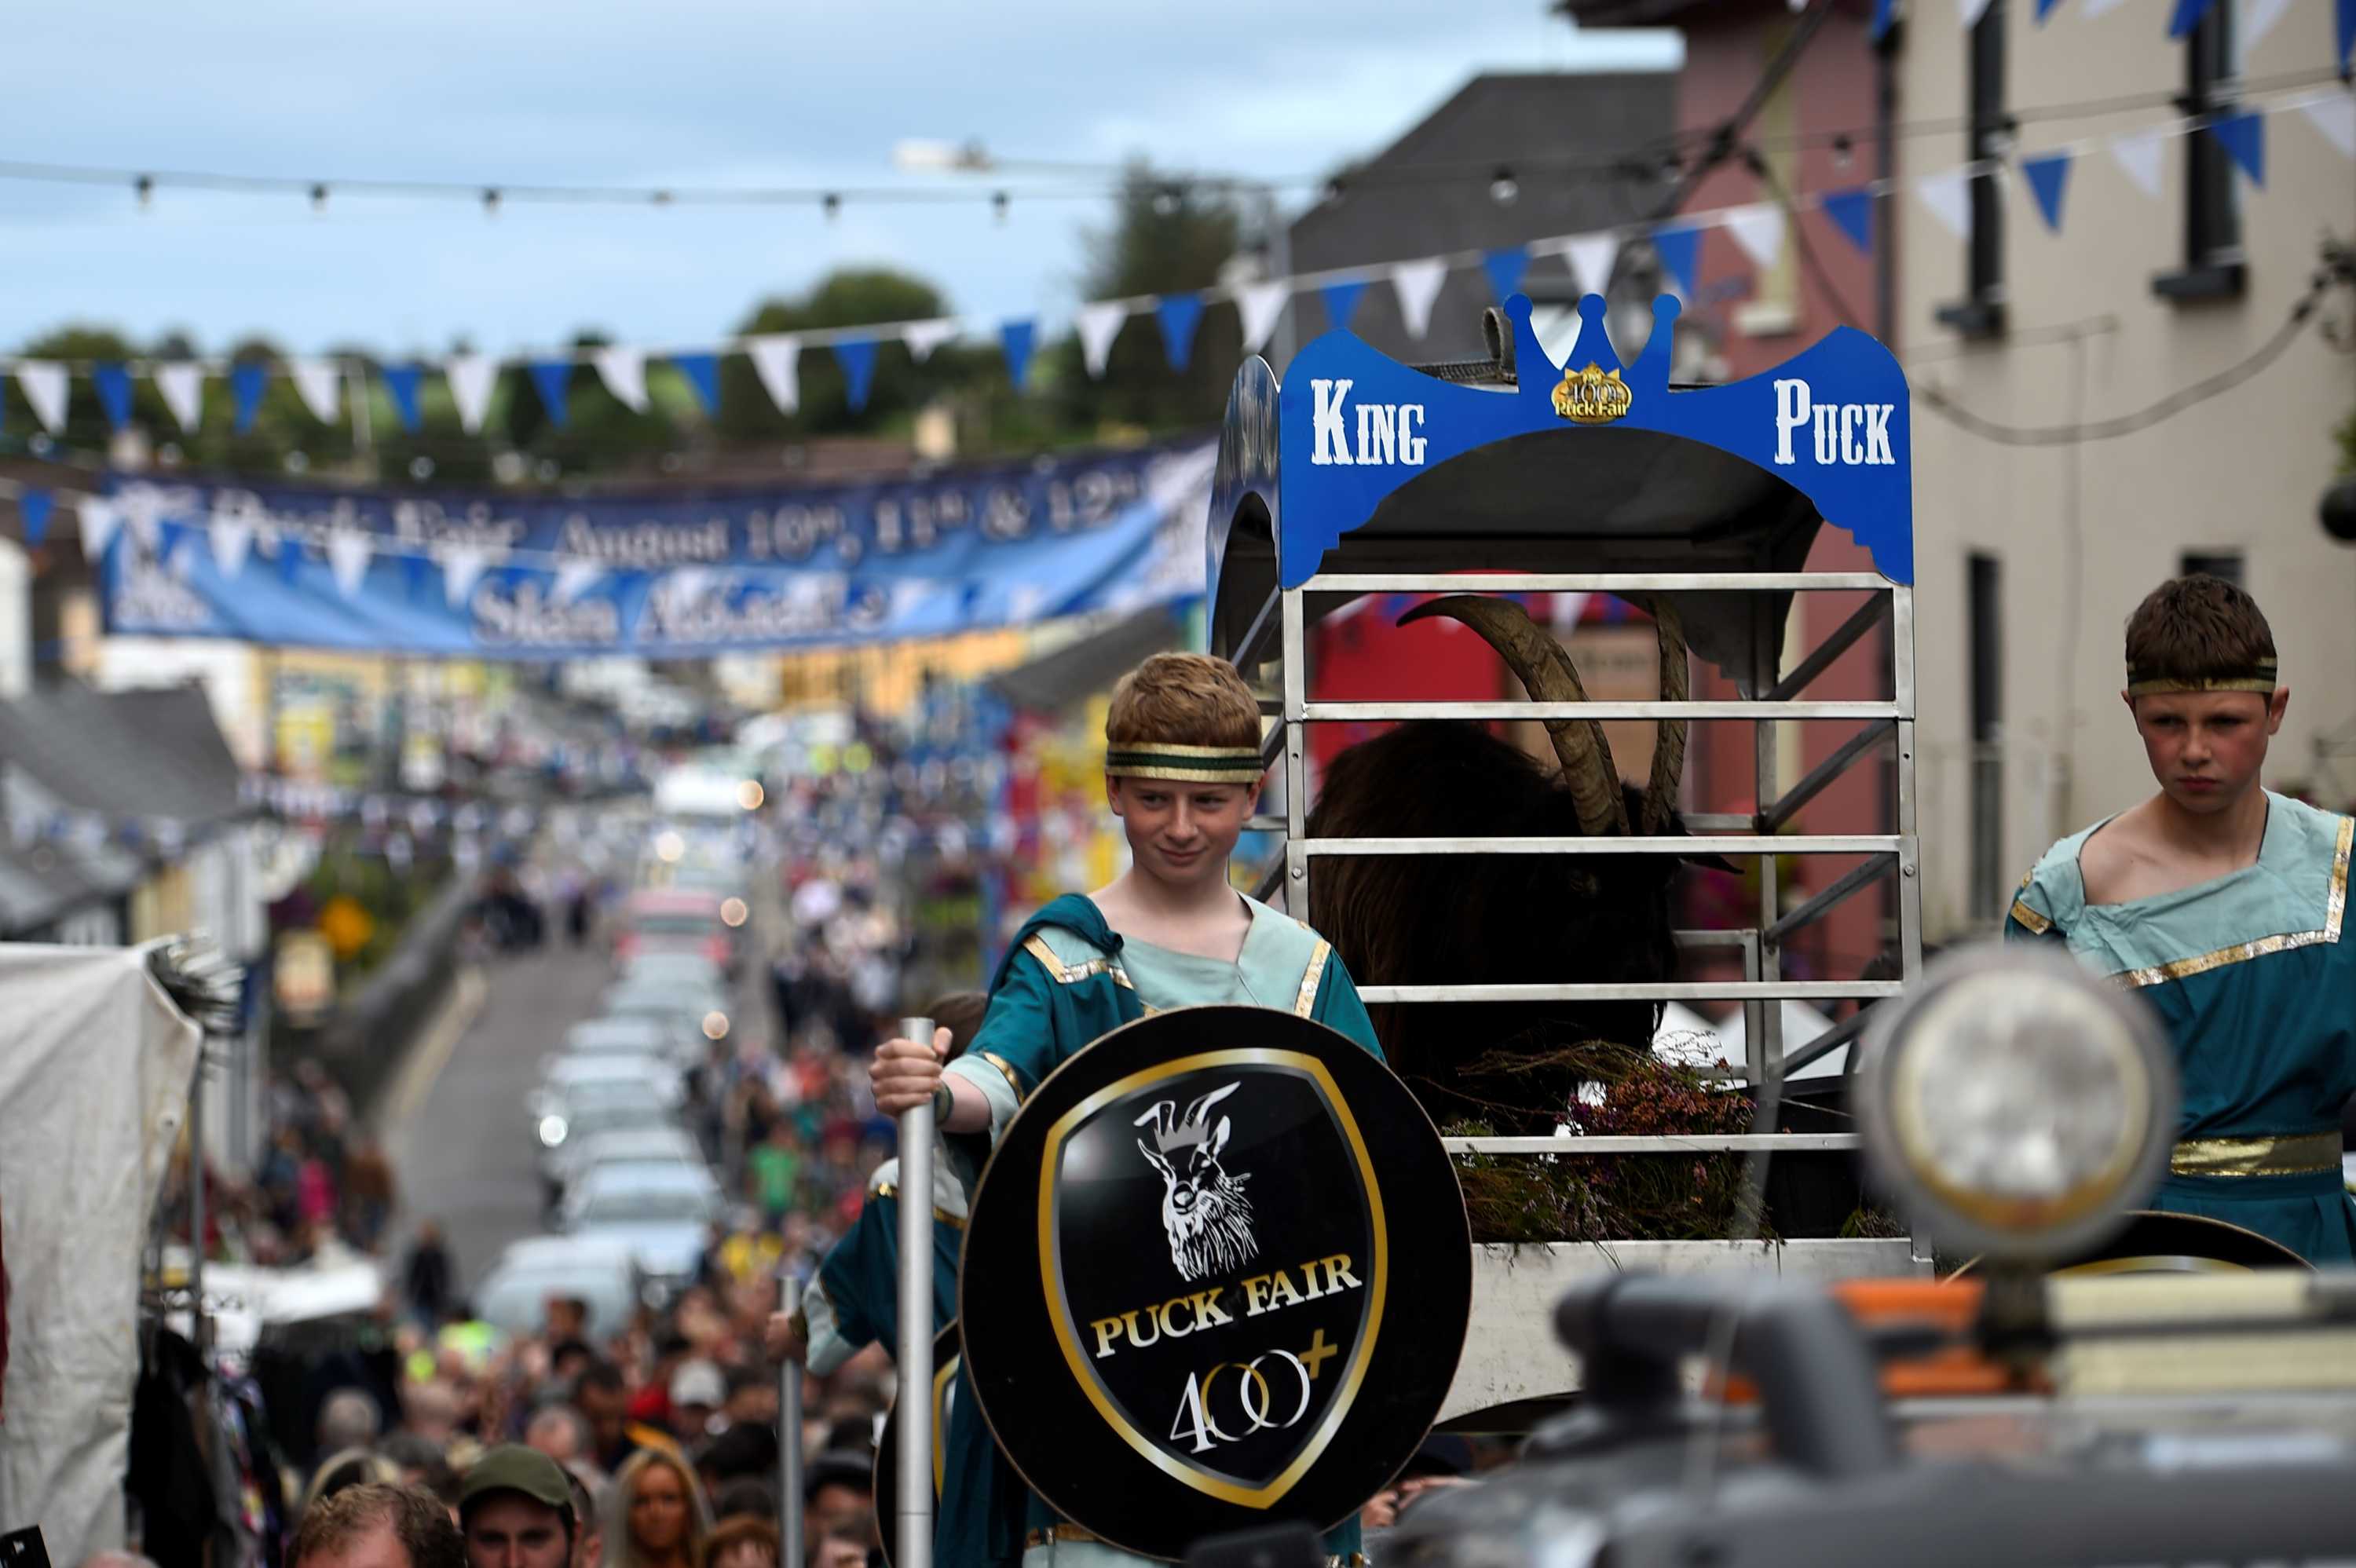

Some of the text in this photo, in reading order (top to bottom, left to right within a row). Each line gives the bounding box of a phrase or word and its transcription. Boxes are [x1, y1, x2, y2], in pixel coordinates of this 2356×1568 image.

[1555, 400, 1626, 416] Puck Fair
[562, 514, 726, 566] August
[982, 484, 1028, 539] &
[1090, 1254, 1362, 1358] PUCK FAIR
[1170, 1329, 1337, 1453] 400+
